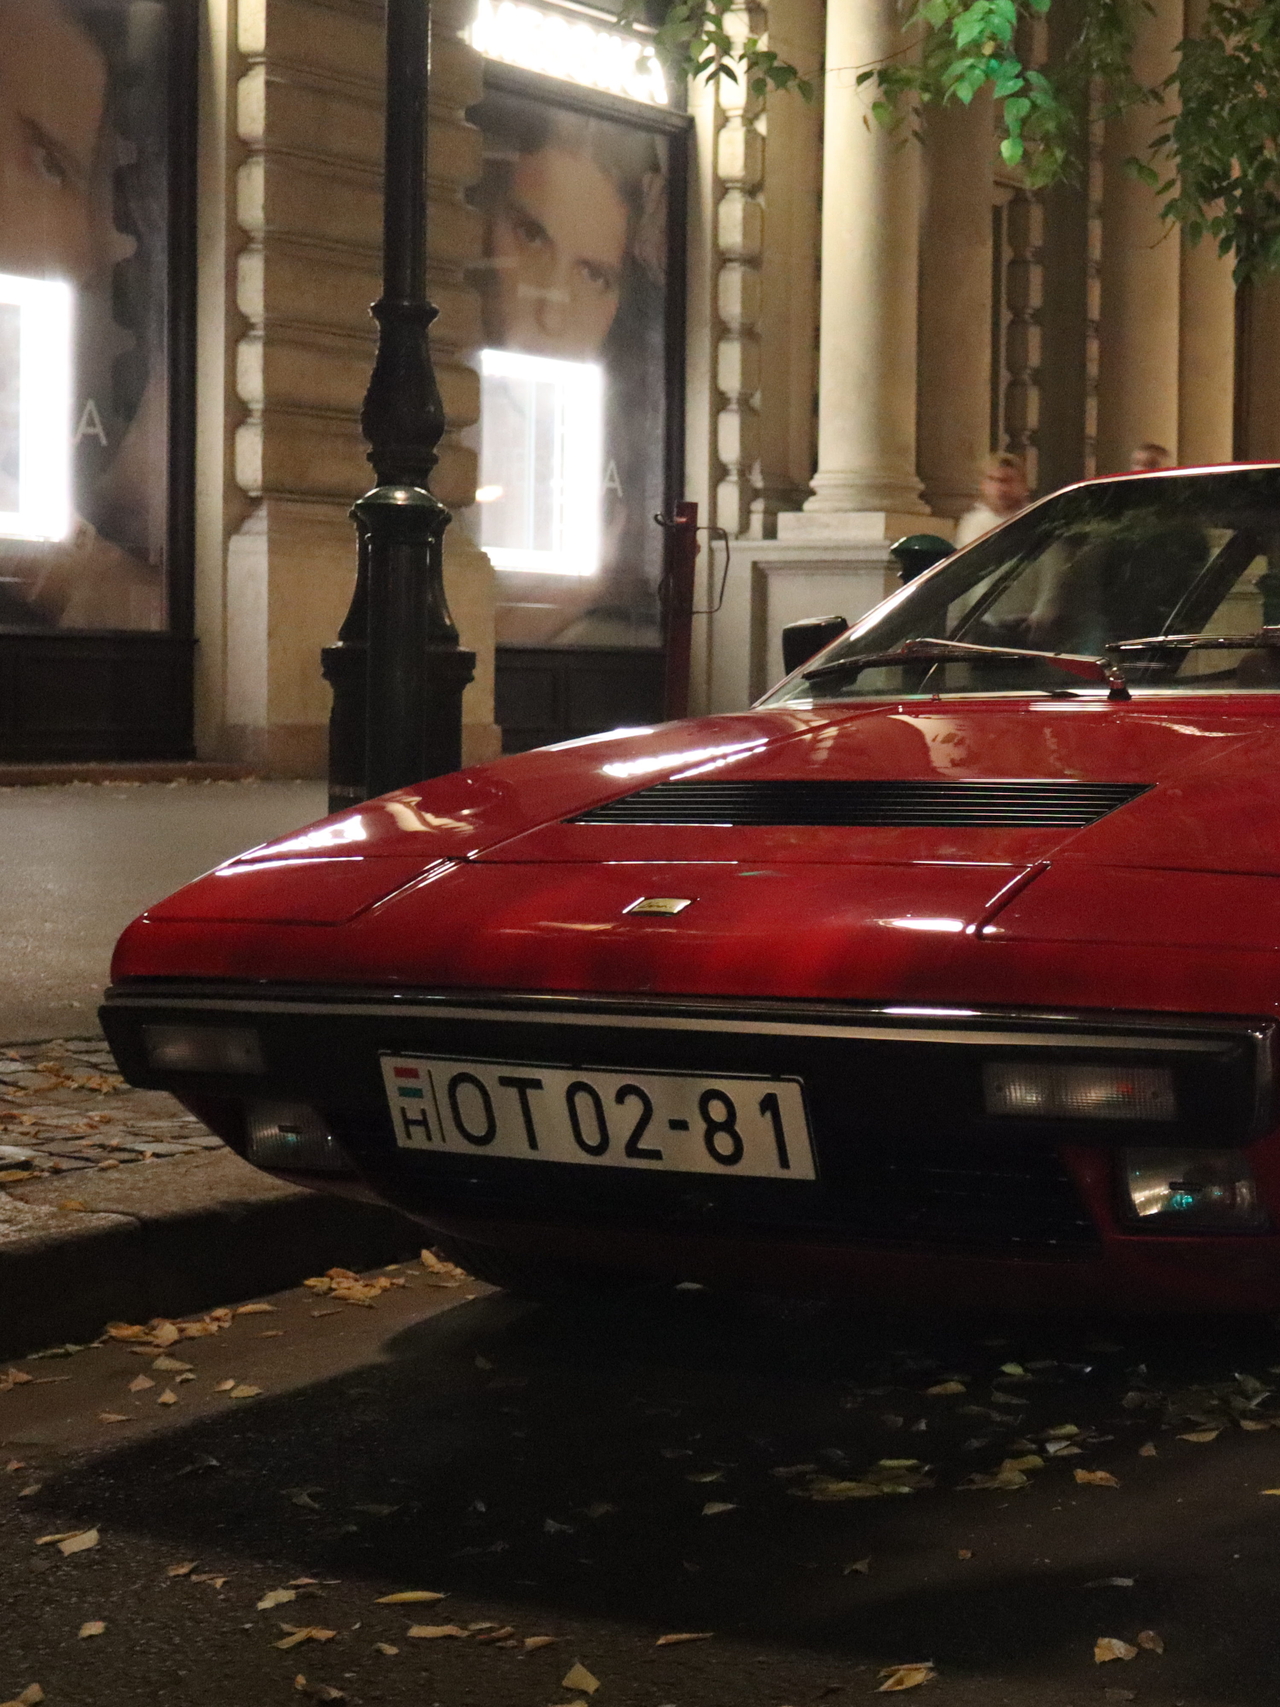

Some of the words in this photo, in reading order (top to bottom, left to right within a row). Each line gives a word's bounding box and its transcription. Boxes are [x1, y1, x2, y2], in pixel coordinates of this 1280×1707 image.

[400, 1105, 432, 1142] H
[446, 1071, 545, 1151] OT
[565, 1080, 791, 1170] 02-81
